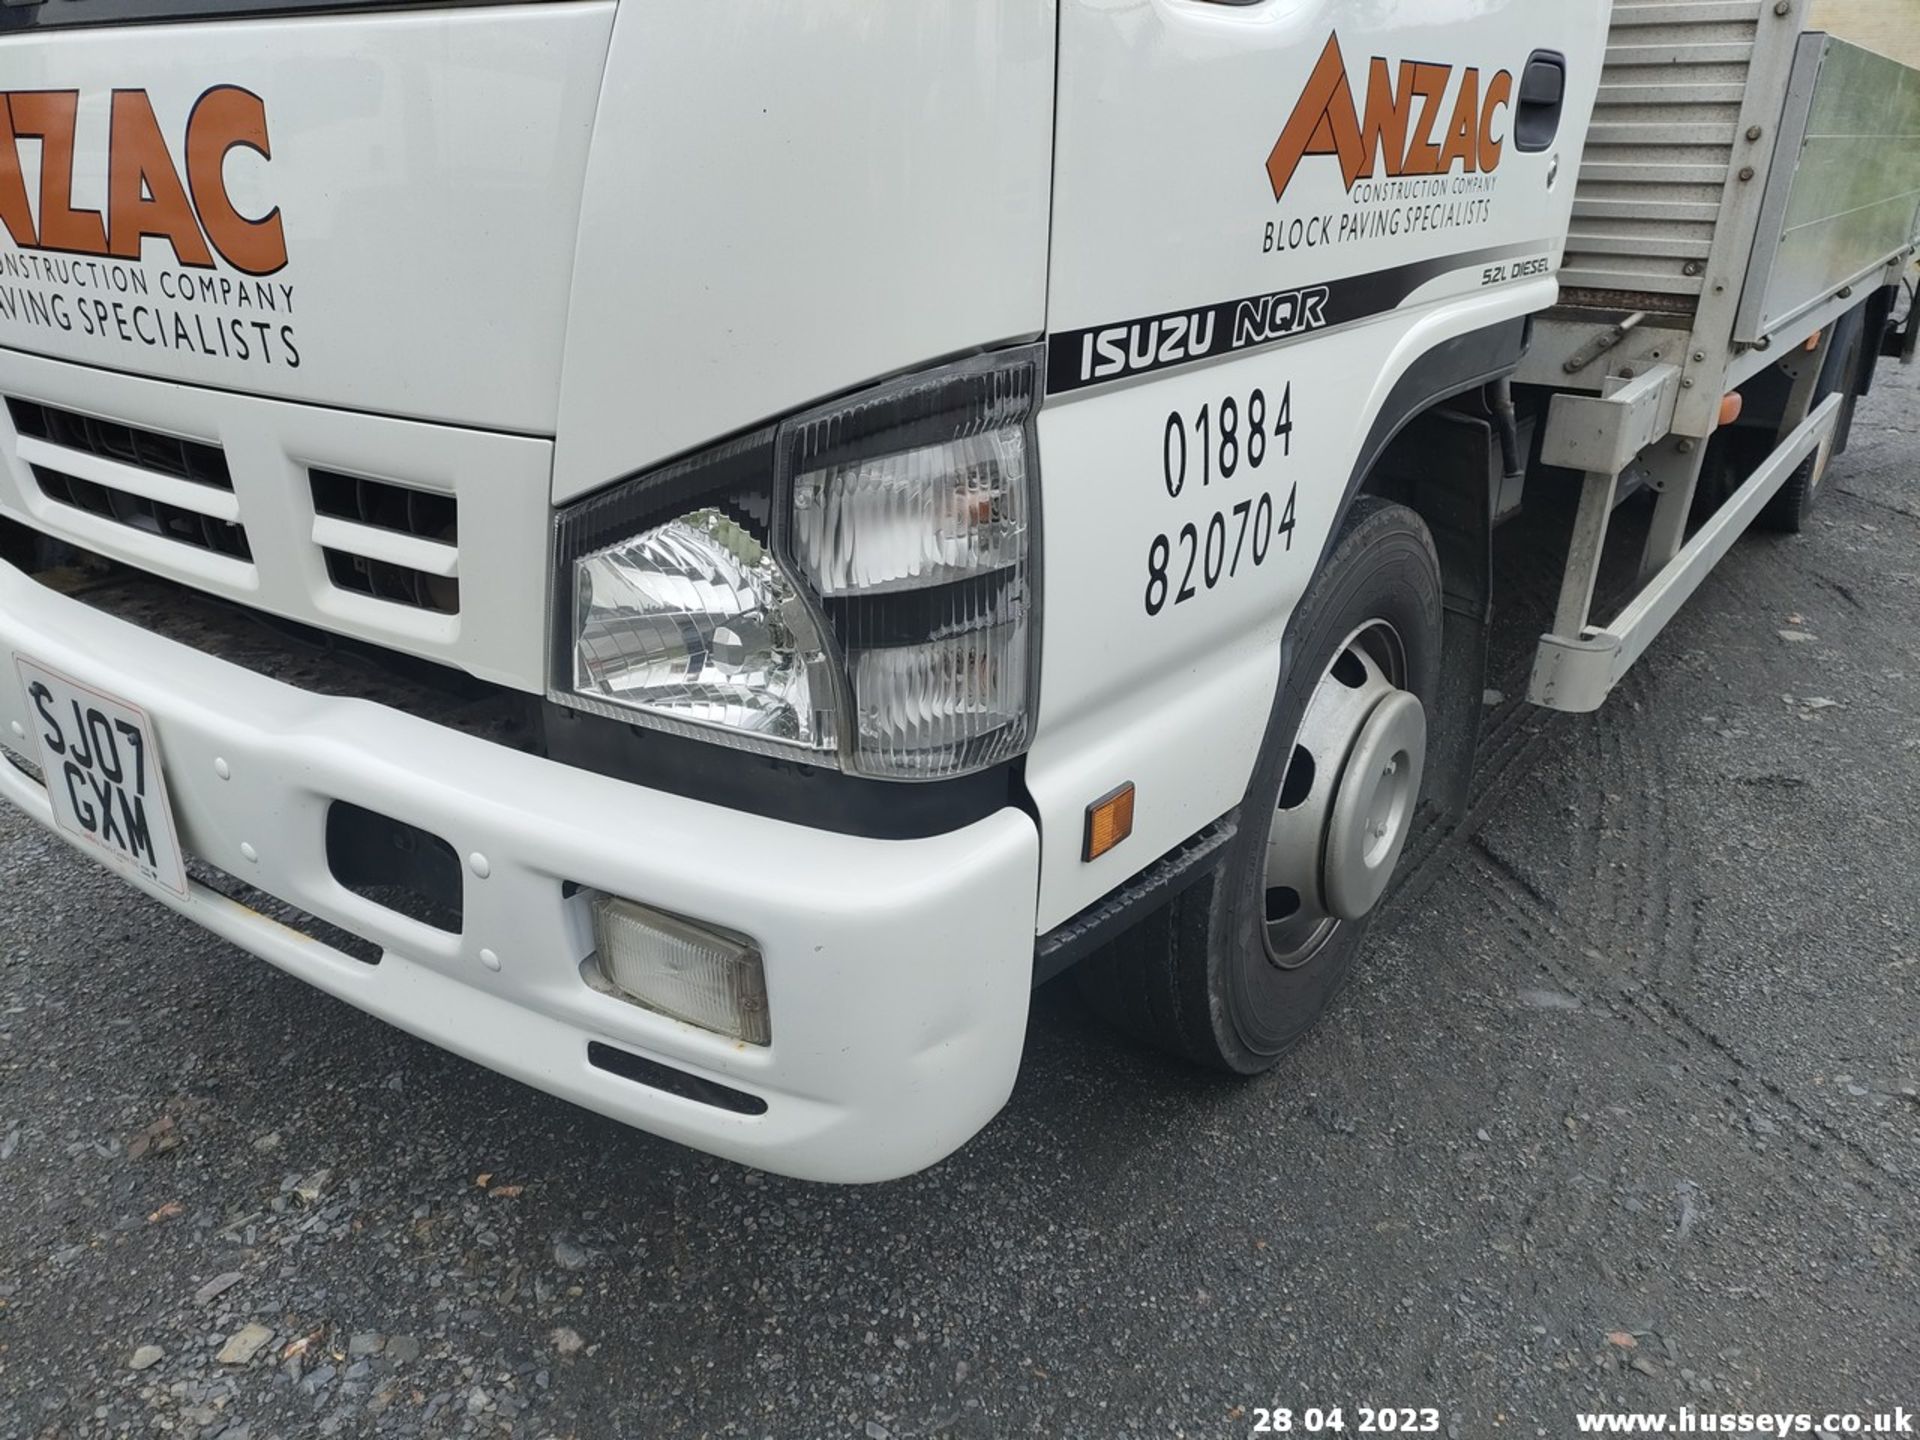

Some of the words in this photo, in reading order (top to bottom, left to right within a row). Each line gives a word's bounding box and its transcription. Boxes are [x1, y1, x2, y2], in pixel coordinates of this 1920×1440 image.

[1265, 28, 1513, 204] ANZAC
[1262, 211, 1334, 253] BLOCK
[1337, 207, 1401, 243] PAVING
[1404, 198, 1491, 233] SPECIALISTS
[1353, 178, 1449, 204] CONSTRUCTION
[1452, 175, 1498, 195] COMPANY
[0, 252, 149, 295] NSTRUCTION
[160, 271, 294, 314] COMPANY
[1511, 257, 1549, 279] DIESEL
[77, 296, 301, 368] SPECIALISTS
[1079, 310, 1216, 381] ISUZU
[1232, 286, 1331, 348] NQR
[1163, 380, 1293, 498] 01884
[1144, 480, 1298, 617] 820704
[28, 680, 145, 797] SJ07
[63, 760, 157, 868] GXM
